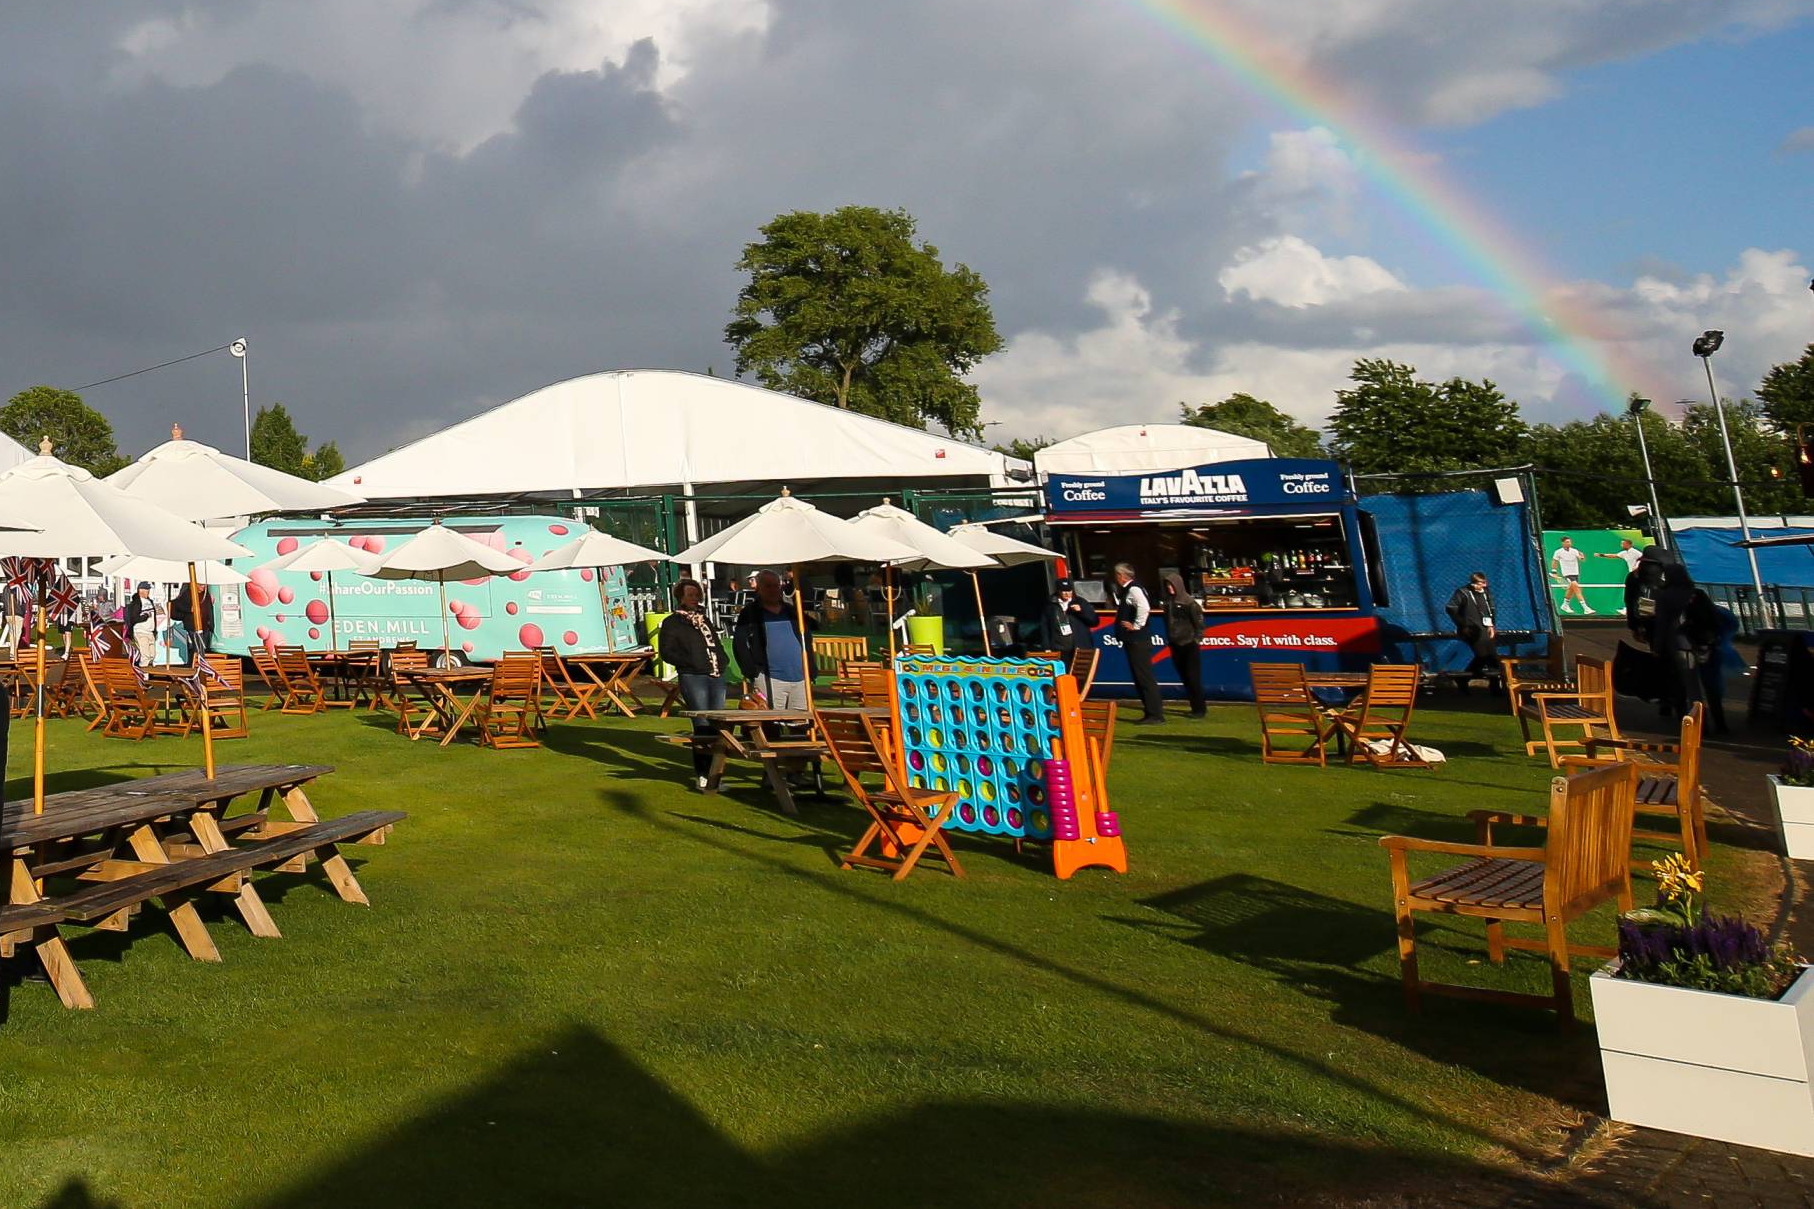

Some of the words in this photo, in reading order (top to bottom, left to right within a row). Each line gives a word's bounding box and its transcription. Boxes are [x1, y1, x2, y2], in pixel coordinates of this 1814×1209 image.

[1140, 469, 1247, 496] LAVAZZA
[1279, 473, 1304, 481] Freshly
[1305, 472, 1329, 481] ground
[1083, 481, 1106, 489] ground
[1283, 481, 1330, 494] Coffee
[1063, 489, 1106, 502] Coffee
[1169, 495, 1215, 504] FAVOURITE
[1214, 494, 1249, 503] COFFEE
[334, 620, 429, 634] EDEN.MILL
[1237, 634, 1259, 648] Say
[1261, 634, 1271, 646] it
[1273, 634, 1302, 646] with
[1304, 634, 1338, 646] class.
